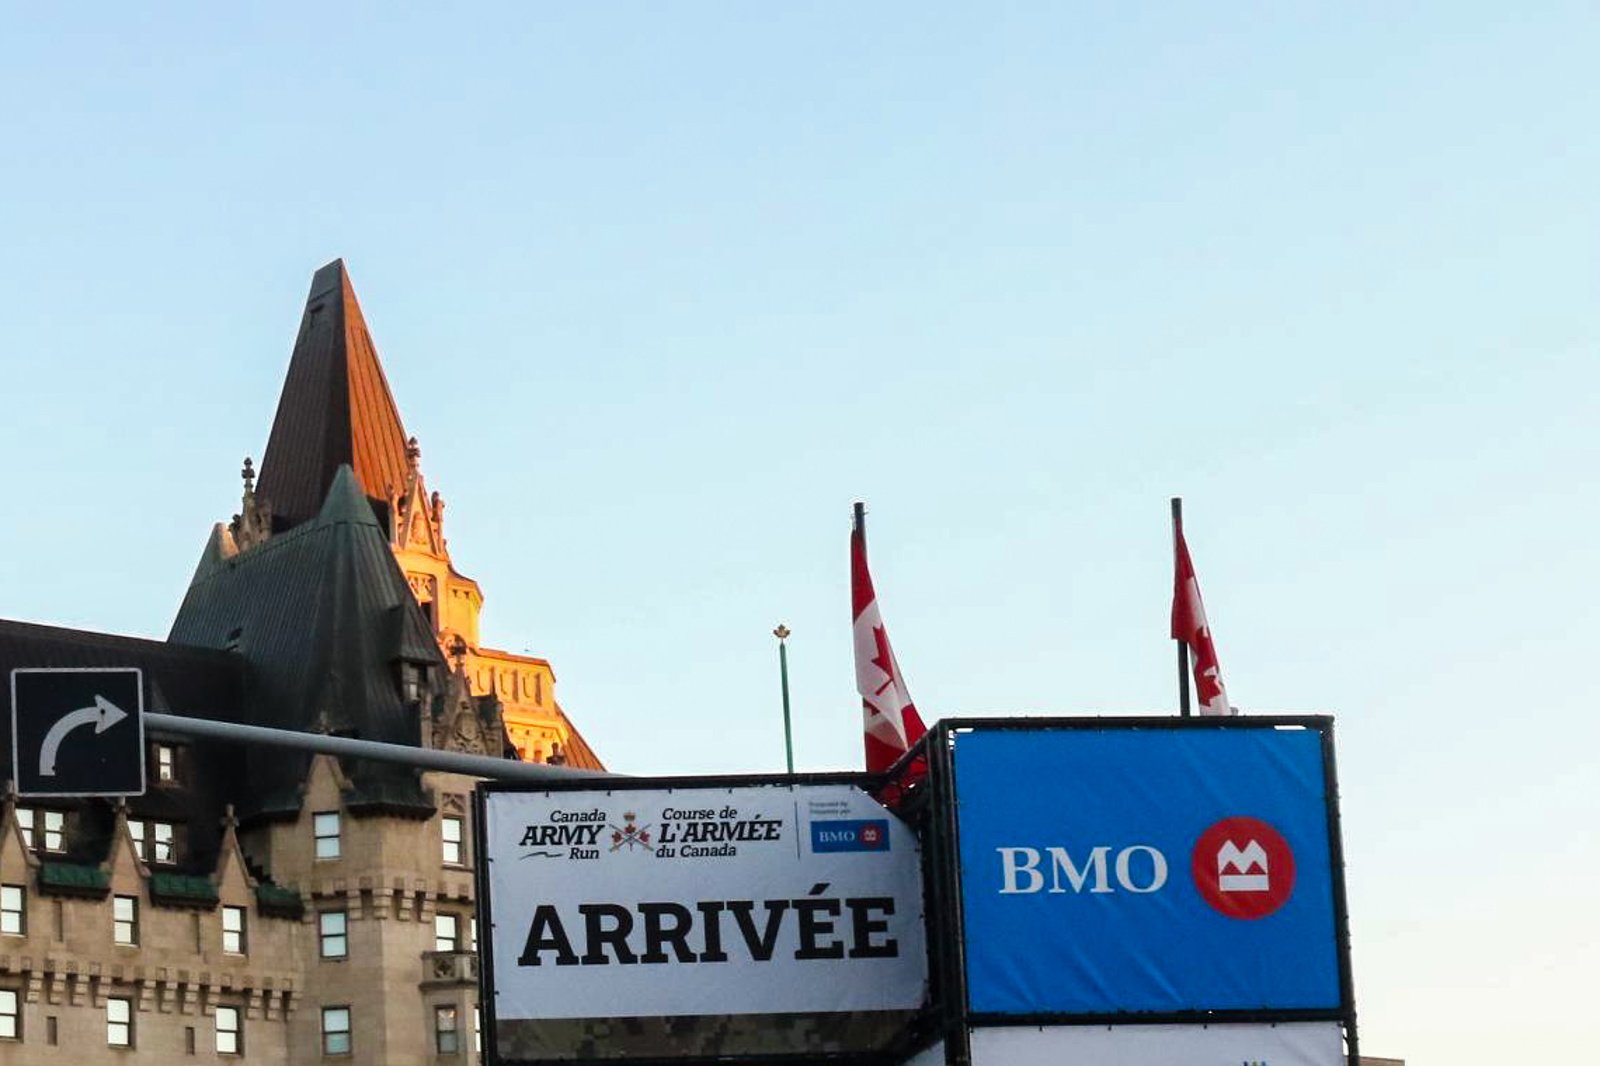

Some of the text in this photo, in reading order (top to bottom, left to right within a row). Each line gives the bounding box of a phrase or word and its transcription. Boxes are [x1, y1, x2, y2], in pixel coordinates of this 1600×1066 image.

[550, 809, 606, 823] Canada
[662, 807, 738, 820] Course de
[519, 823, 605, 846] ARMY
[658, 814, 782, 843] L'ARMÉE
[819, 831, 855, 842] BMO
[569, 847, 599, 860] Run
[656, 844, 736, 858] du Canada
[996, 845, 1168, 894] BMO
[518, 883, 898, 966] ARRIVÉE
